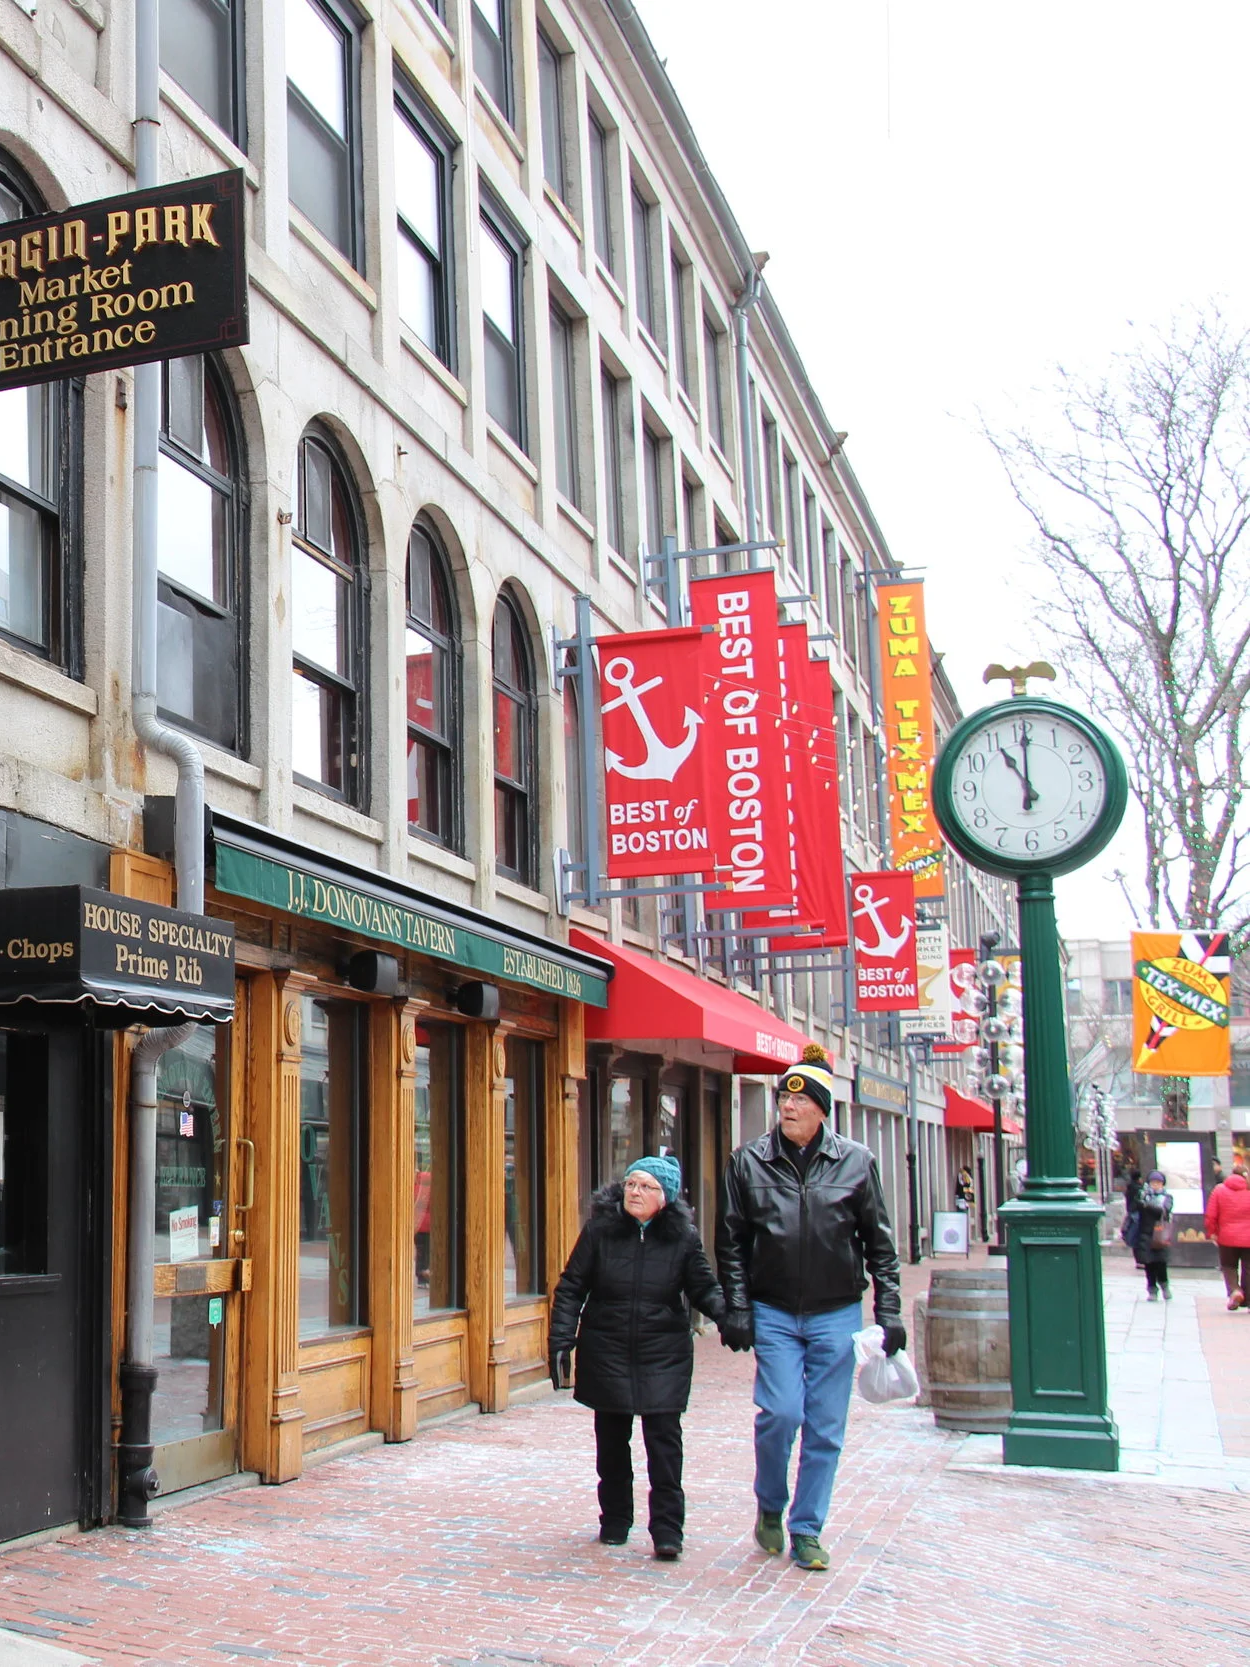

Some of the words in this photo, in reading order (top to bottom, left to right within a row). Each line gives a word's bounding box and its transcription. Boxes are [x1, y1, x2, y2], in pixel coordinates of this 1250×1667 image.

[19, 259, 132, 307] Market
[89, 280, 195, 323] Room
[716, 589, 755, 679] BEST
[887, 594, 920, 678] ZUMA
[722, 689, 759, 736] OF
[986, 732, 1000, 752] 11
[1051, 728, 1058, 748] 1
[966, 752, 985, 774] 10
[1068, 743, 1083, 765] 2
[962, 780, 977, 801] 9
[1078, 770, 1093, 792] 3
[610, 800, 669, 825] BEST
[674, 799, 698, 826] of
[724, 747, 766, 893] BOSTON
[973, 807, 988, 828] 8
[1070, 800, 1087, 821] 4
[612, 827, 708, 855] BOSTON
[994, 827, 1009, 848] 7
[1025, 830, 1040, 852] 6
[1054, 818, 1068, 841] 5
[84, 902, 142, 939] HOUSE
[148, 922, 232, 958] SPECIALTY
[287, 869, 308, 914] J.J.
[313, 880, 402, 939] DONOVAN'S
[404, 913, 455, 956] TAVERN
[502, 947, 564, 990] ESTABLISHED
[566, 971, 582, 997] 1826
[7, 939, 74, 965] Chops
[115, 944, 168, 980] Prime
[175, 955, 203, 986] Rib
[858, 967, 892, 981] BEST
[894, 967, 910, 982] of
[1171, 958, 1218, 994] ZUMA
[859, 984, 915, 998] BOSTON
[1148, 996, 1188, 1027] GRILL
[756, 1031, 772, 1051] BEST
